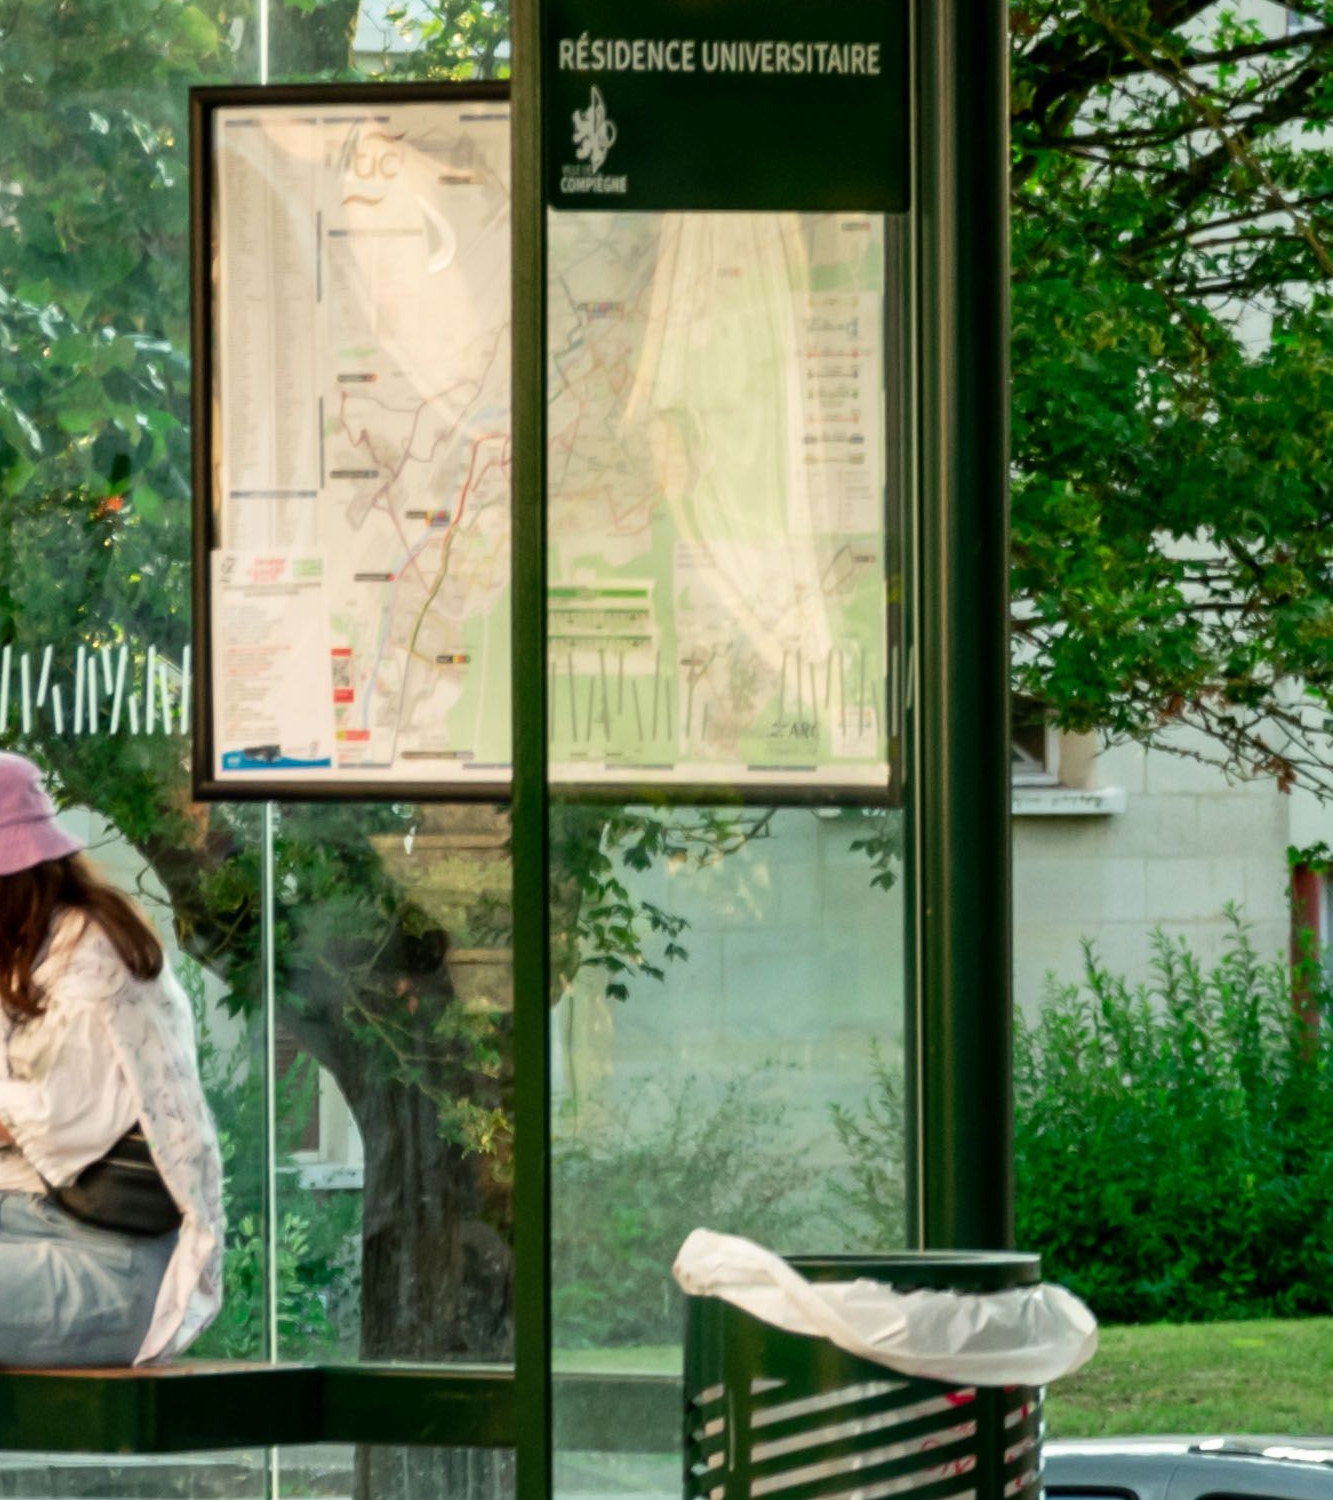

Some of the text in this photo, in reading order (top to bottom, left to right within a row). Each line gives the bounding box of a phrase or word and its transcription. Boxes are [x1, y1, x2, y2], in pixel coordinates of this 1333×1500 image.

[559, 31, 882, 75] RÉSIDENCE UNIVERSITAIRE
[560, 172, 628, 193] COMPIÈGNE
